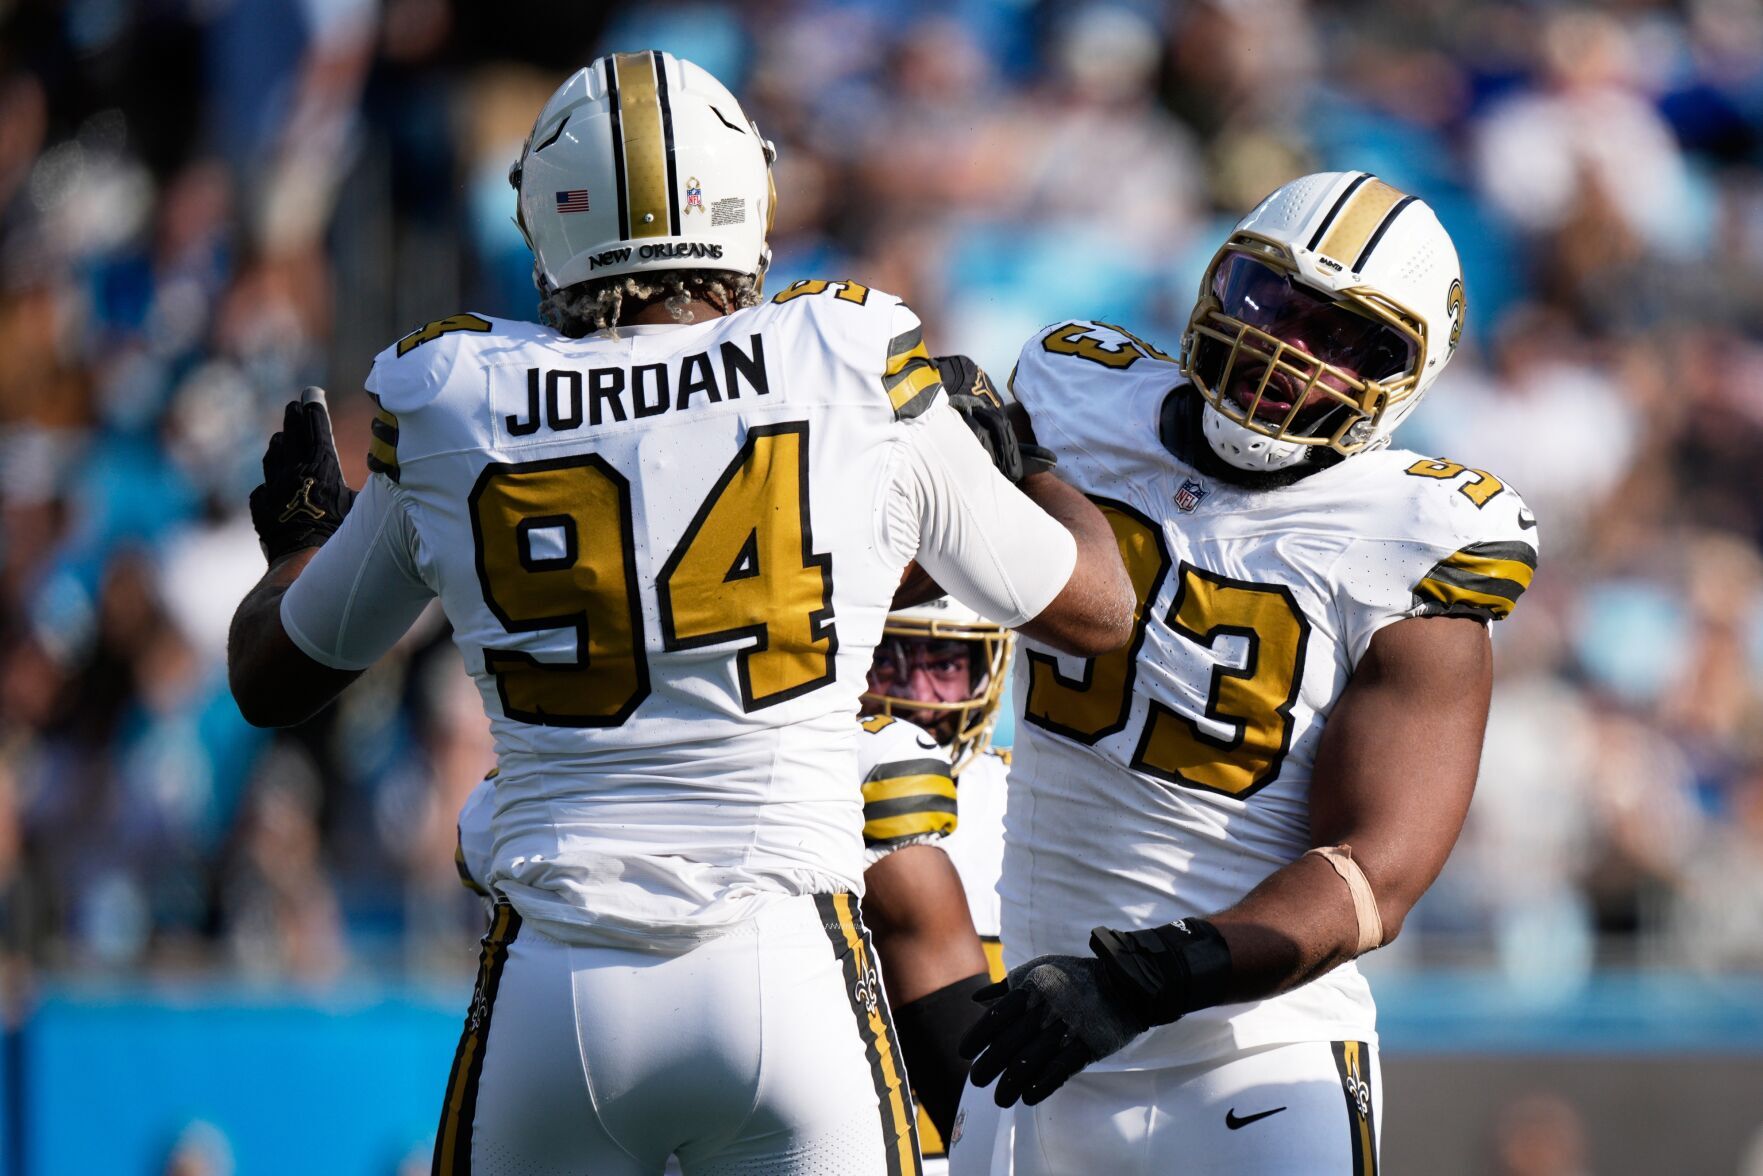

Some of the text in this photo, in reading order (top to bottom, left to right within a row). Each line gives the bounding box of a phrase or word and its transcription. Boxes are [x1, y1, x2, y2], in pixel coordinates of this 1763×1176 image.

[588, 242, 723, 271] NEW ORLEANS
[505, 333, 770, 437] JORDAN
[1176, 488, 1196, 509] NFL
[467, 420, 839, 727] 94
